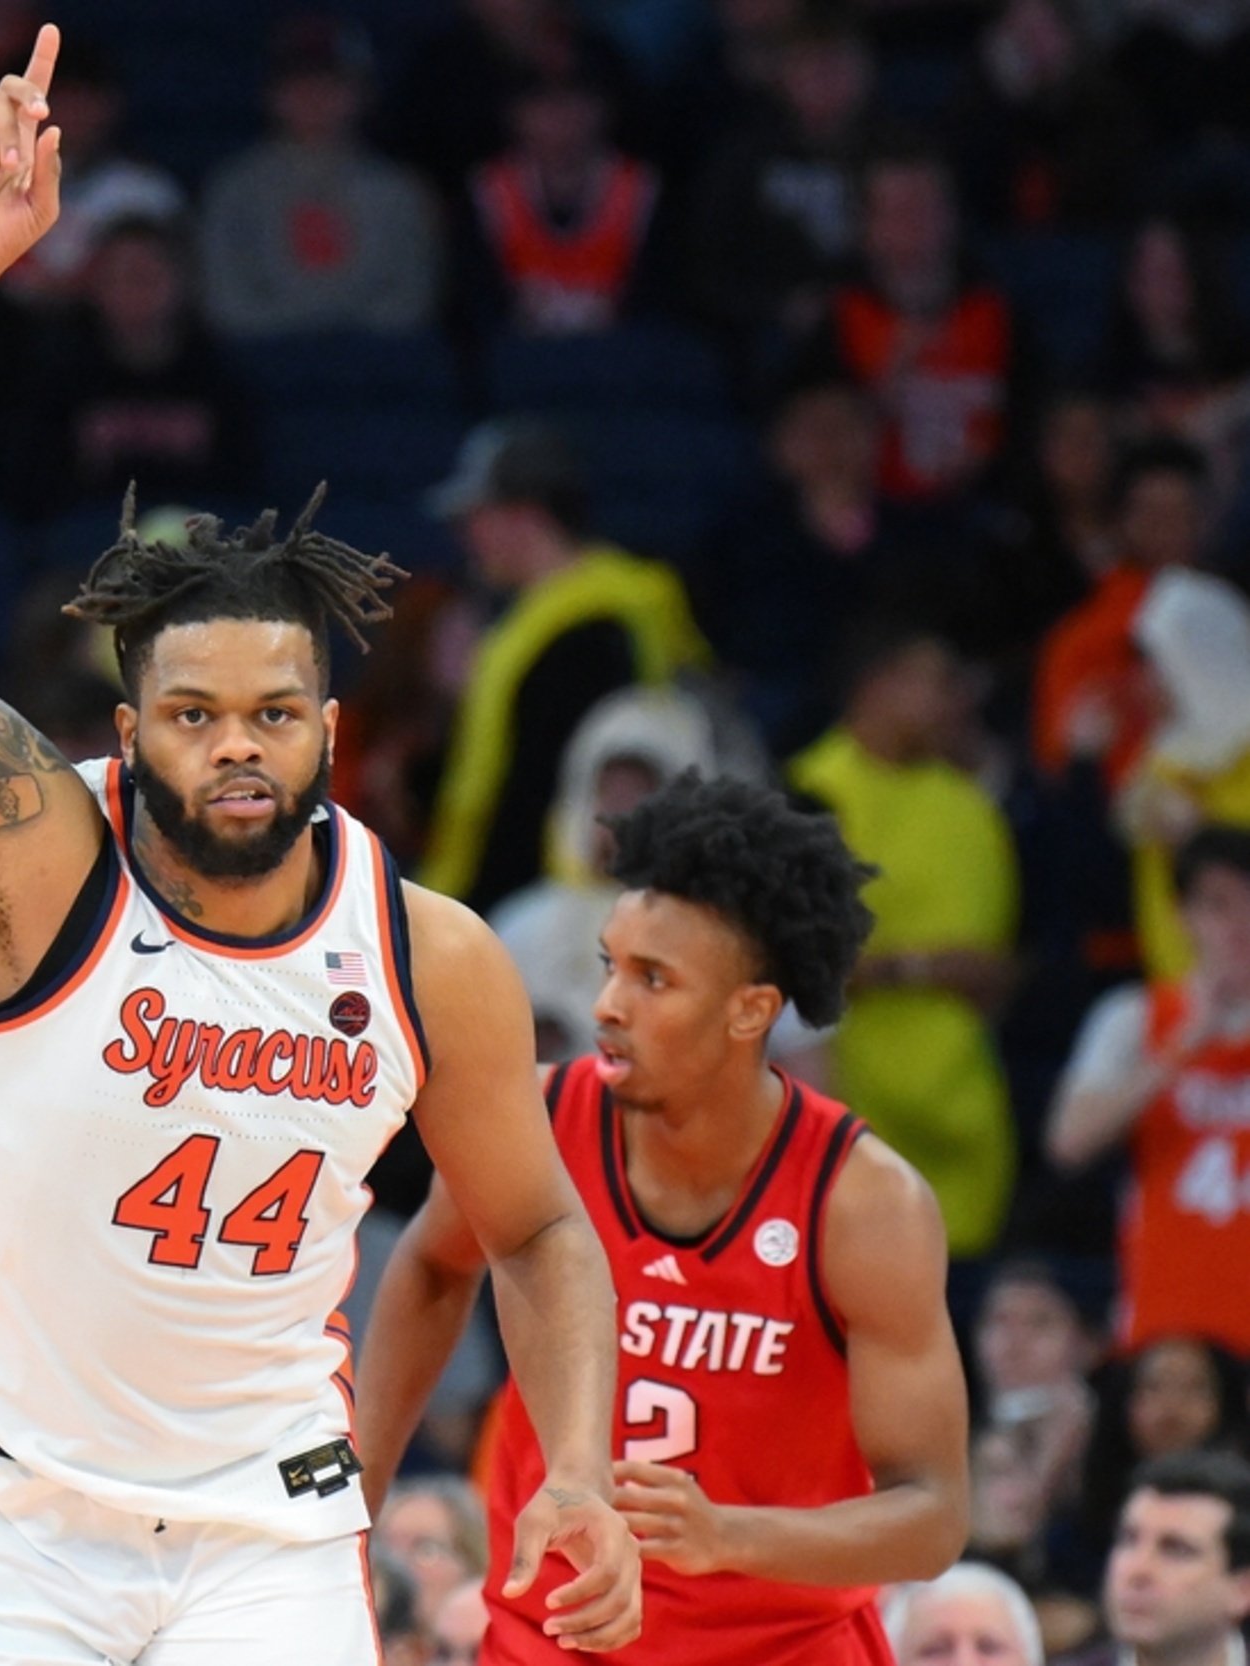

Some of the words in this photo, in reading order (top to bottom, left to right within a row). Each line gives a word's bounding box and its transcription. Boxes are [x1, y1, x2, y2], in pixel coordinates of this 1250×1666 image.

[103, 986, 378, 1107] Syracuse
[111, 1133, 326, 1276] 44
[619, 1300, 795, 1376] STATE
[623, 1376, 698, 1468] 2
